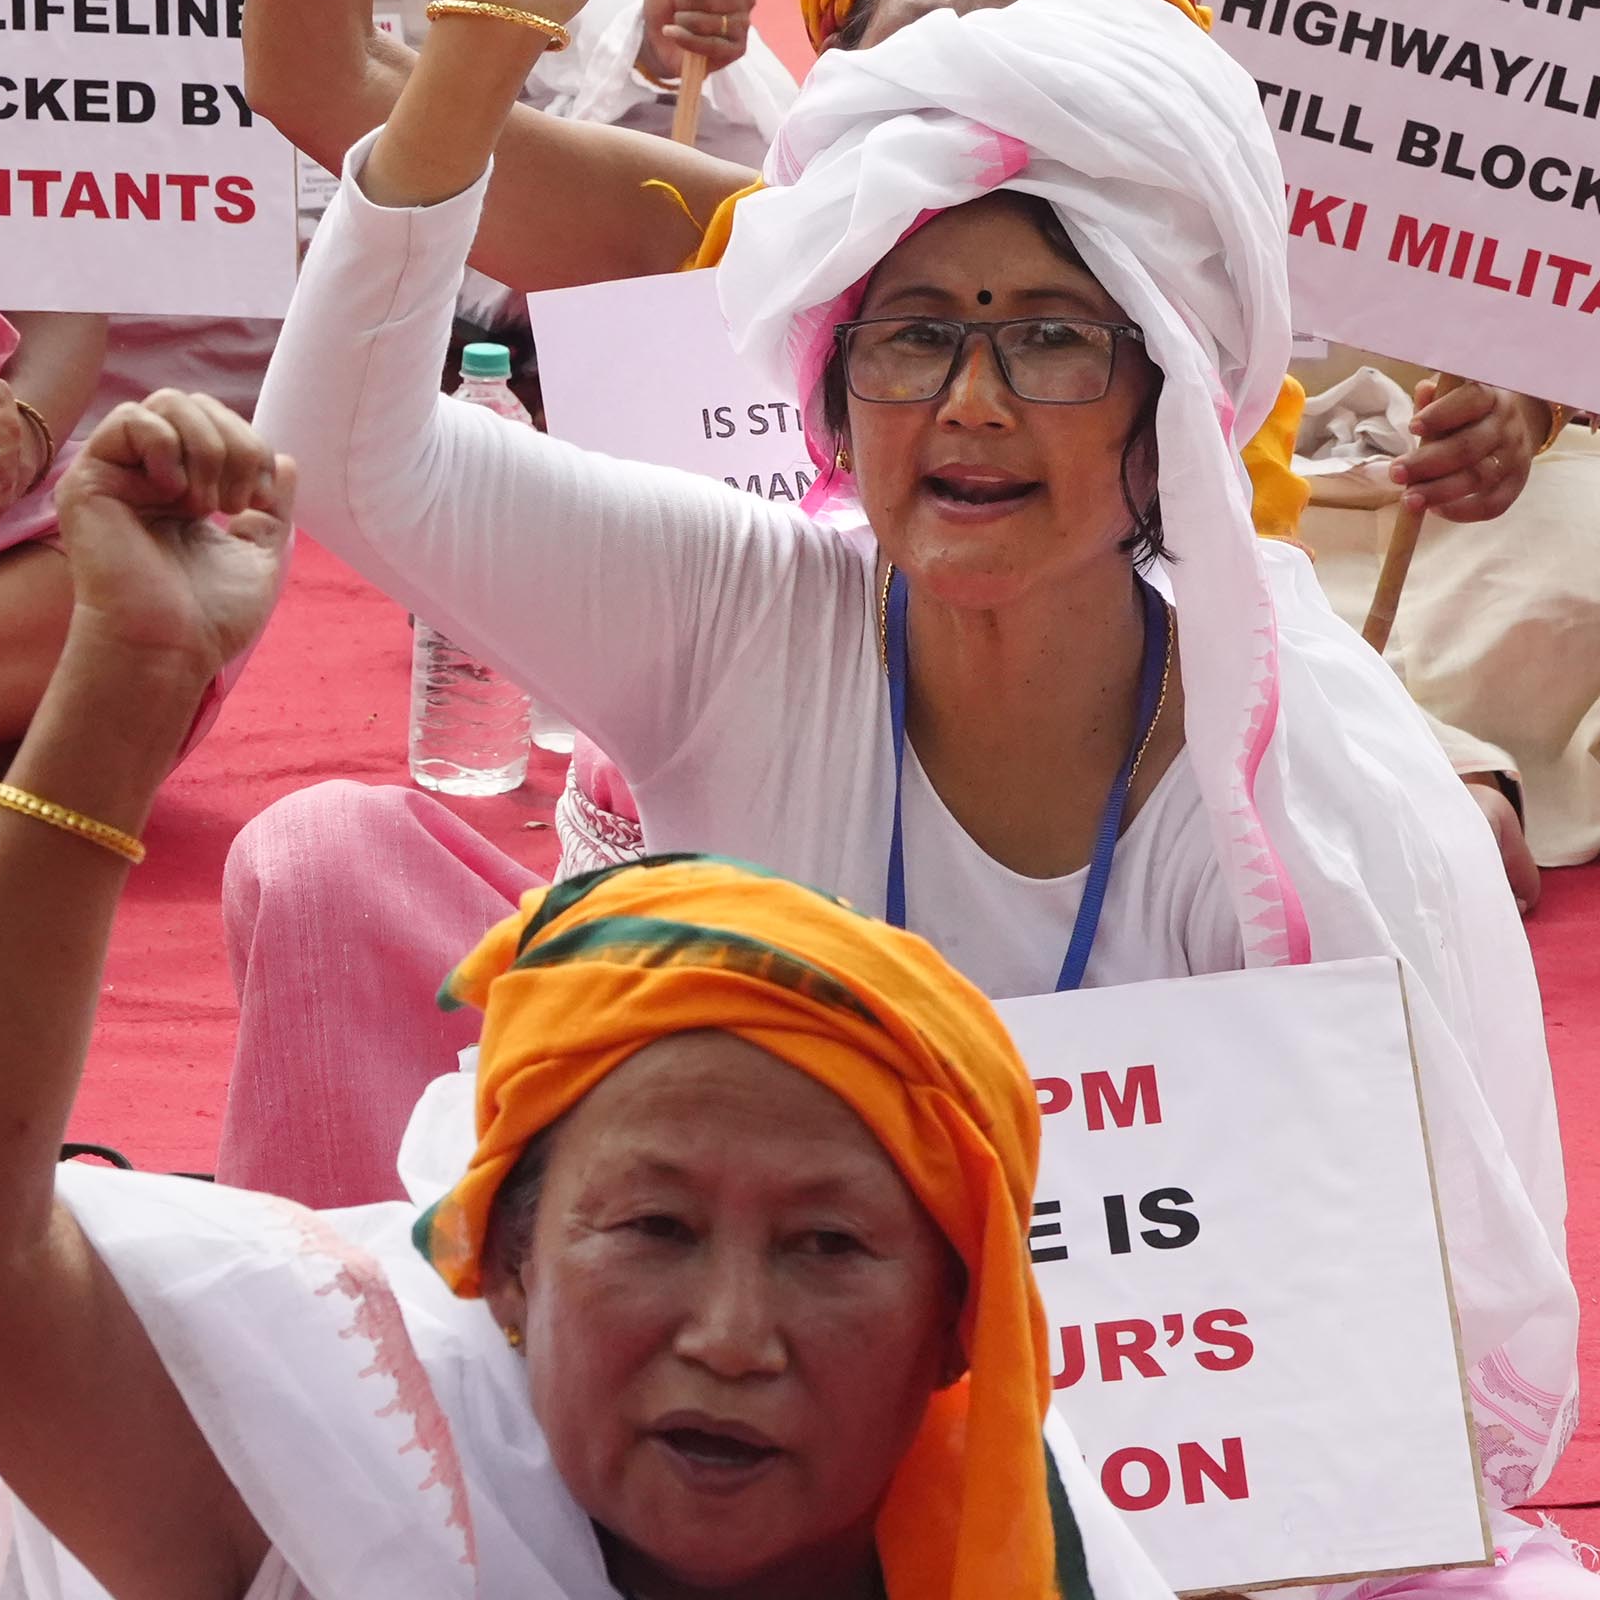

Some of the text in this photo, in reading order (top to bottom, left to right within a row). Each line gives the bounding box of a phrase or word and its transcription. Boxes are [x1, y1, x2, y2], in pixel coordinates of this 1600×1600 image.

[182, 82, 255, 128] BY
[1253, 78, 1374, 154] TILL
[702, 406, 736, 439] IS
[1103, 1187, 1200, 1255] IS
